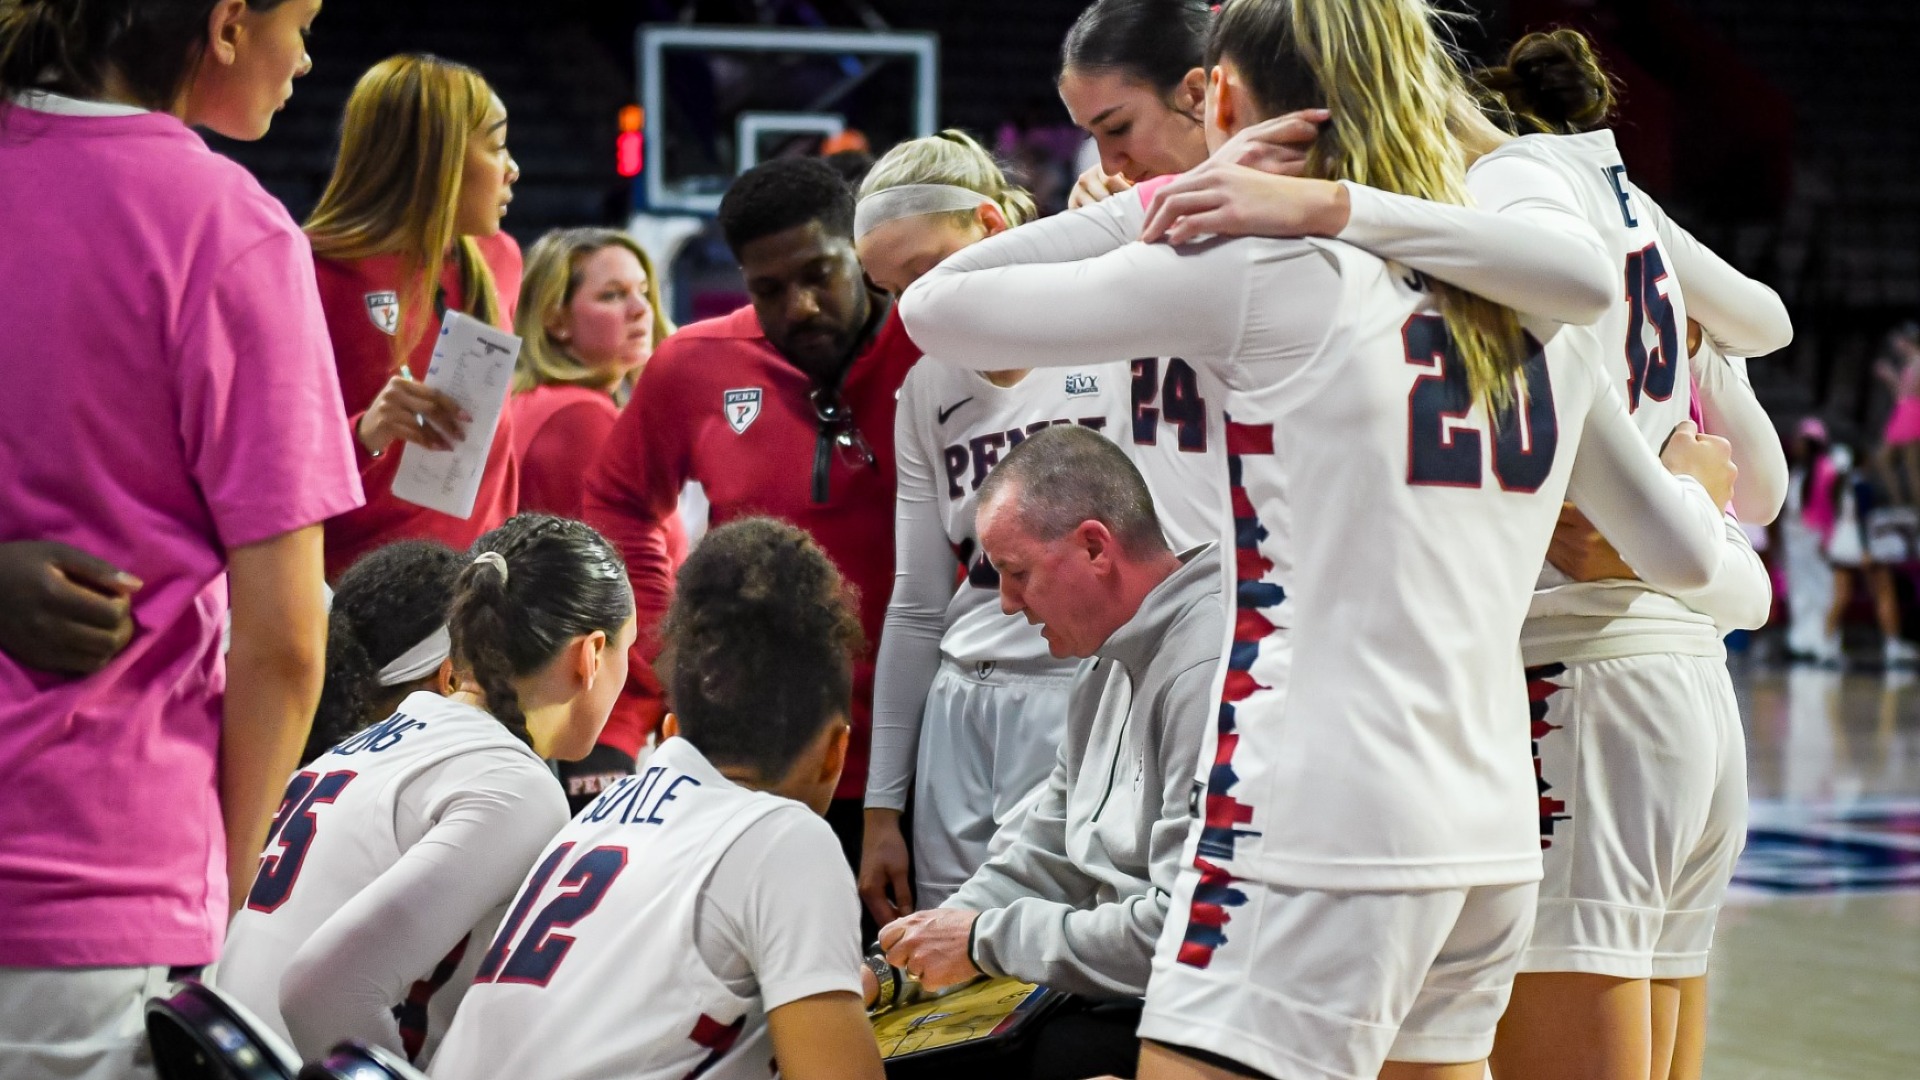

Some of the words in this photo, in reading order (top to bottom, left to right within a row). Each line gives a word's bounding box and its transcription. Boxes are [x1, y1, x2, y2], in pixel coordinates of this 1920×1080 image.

[1624, 241, 1678, 416] 15
[728, 391, 757, 402] PENN
[1130, 357, 1207, 453] 24
[1401, 313, 1558, 494] 20
[944, 416, 1107, 500] PE
[474, 841, 628, 988] 12
